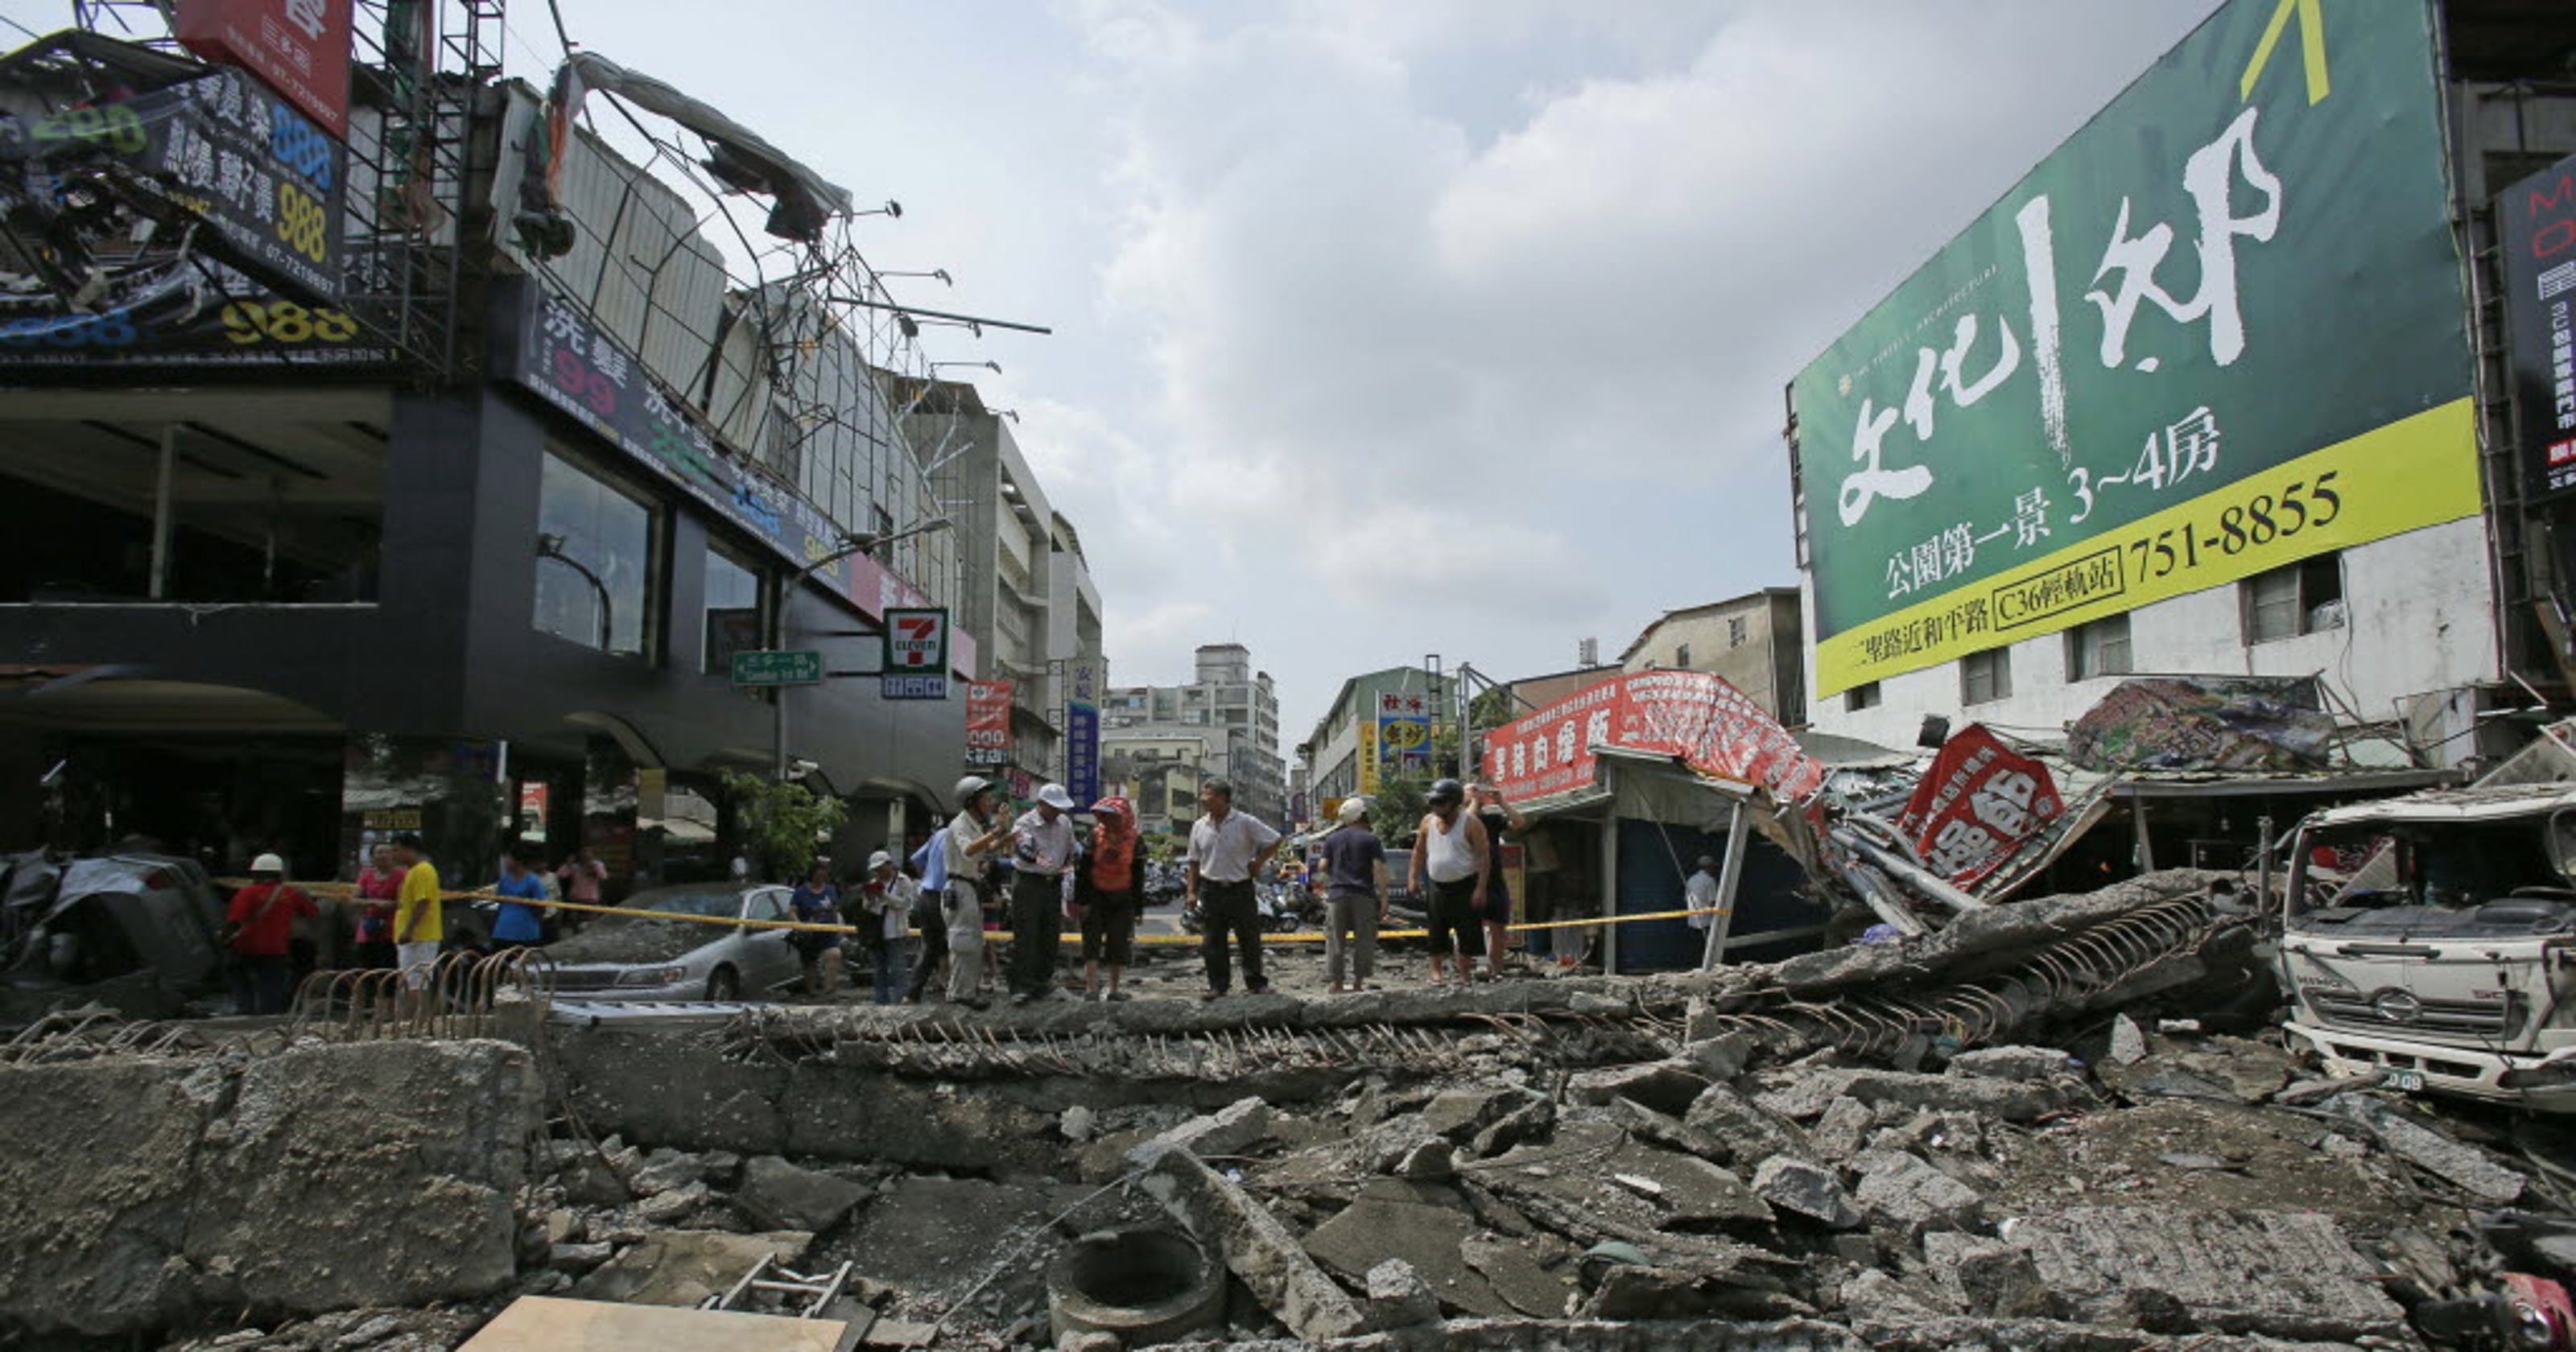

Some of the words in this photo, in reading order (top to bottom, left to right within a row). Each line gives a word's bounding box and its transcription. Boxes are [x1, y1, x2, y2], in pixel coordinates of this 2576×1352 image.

[278, 182, 326, 263] 988
[555, 348, 616, 414] 99
[1885, 485, 2052, 600] 公園第一景
[1998, 557, 2116, 622] C36輕軌站
[2130, 471, 2342, 583] 751-8855
